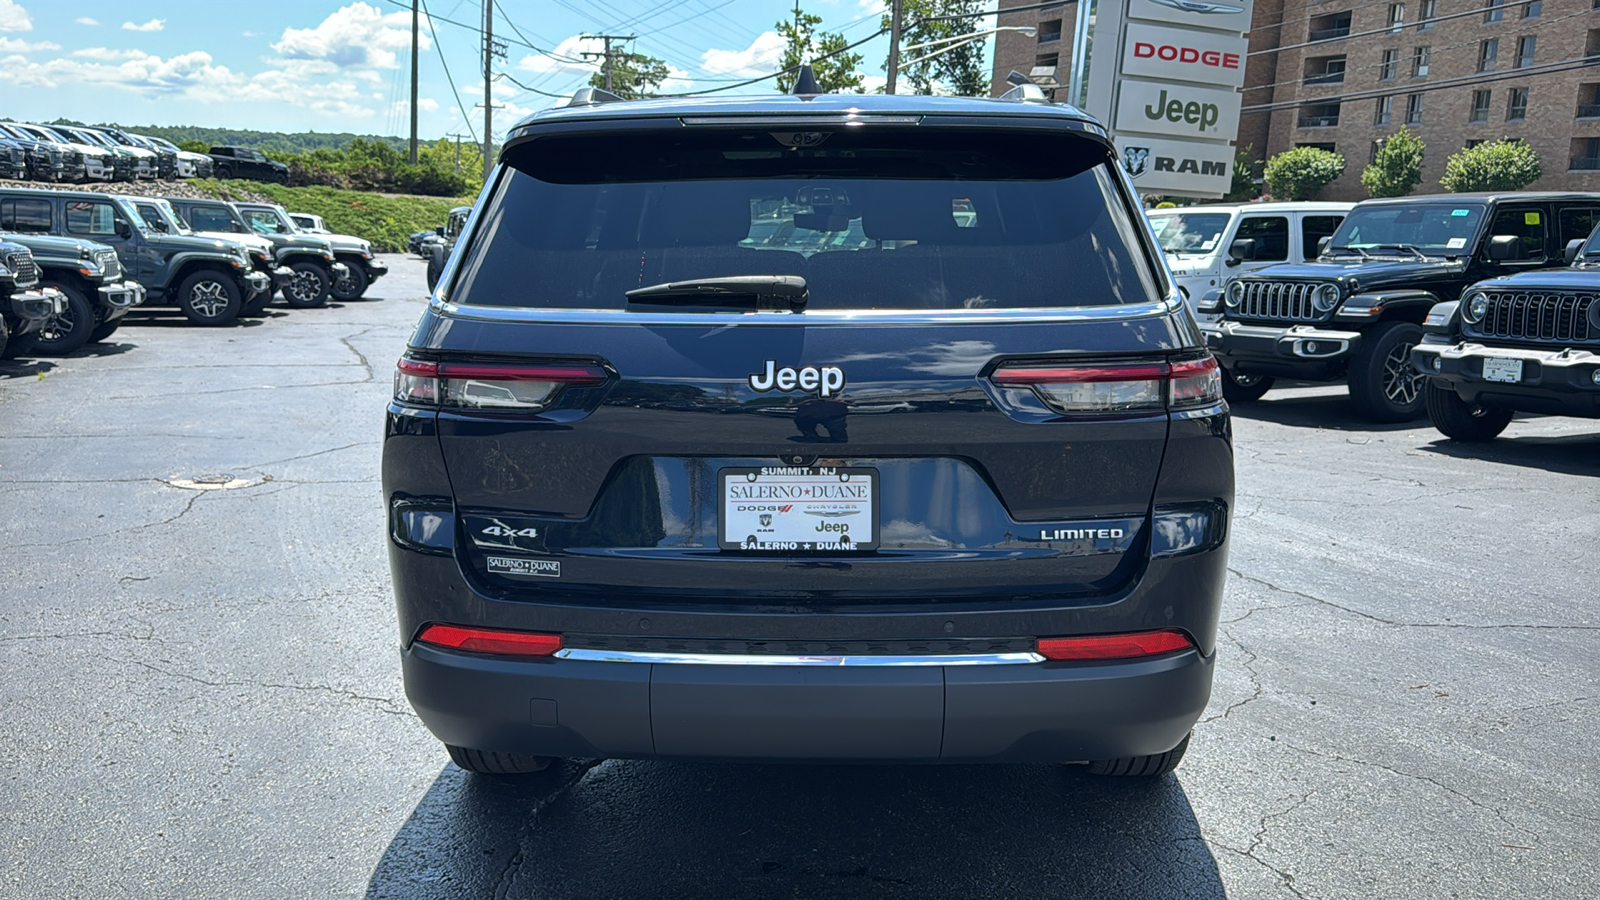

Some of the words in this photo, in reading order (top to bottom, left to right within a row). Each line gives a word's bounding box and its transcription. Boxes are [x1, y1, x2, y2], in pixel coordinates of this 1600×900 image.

[1134, 42, 1240, 69] DODGE
[1145, 90, 1219, 131] Jeep
[1154, 156, 1226, 176] RAM
[750, 360, 844, 397] Jeep
[819, 467, 837, 475] NJ
[730, 485, 802, 499] SALERNO
[812, 485, 867, 498] DUANE
[481, 526, 538, 538] 4x4
[815, 520, 849, 534] Jeep
[1040, 528, 1124, 540] LIMITED
[740, 542, 798, 550] SALERNO
[816, 542, 858, 550] DUANE
[489, 558, 524, 568] SALERNO
[530, 561, 558, 571] DUANE
